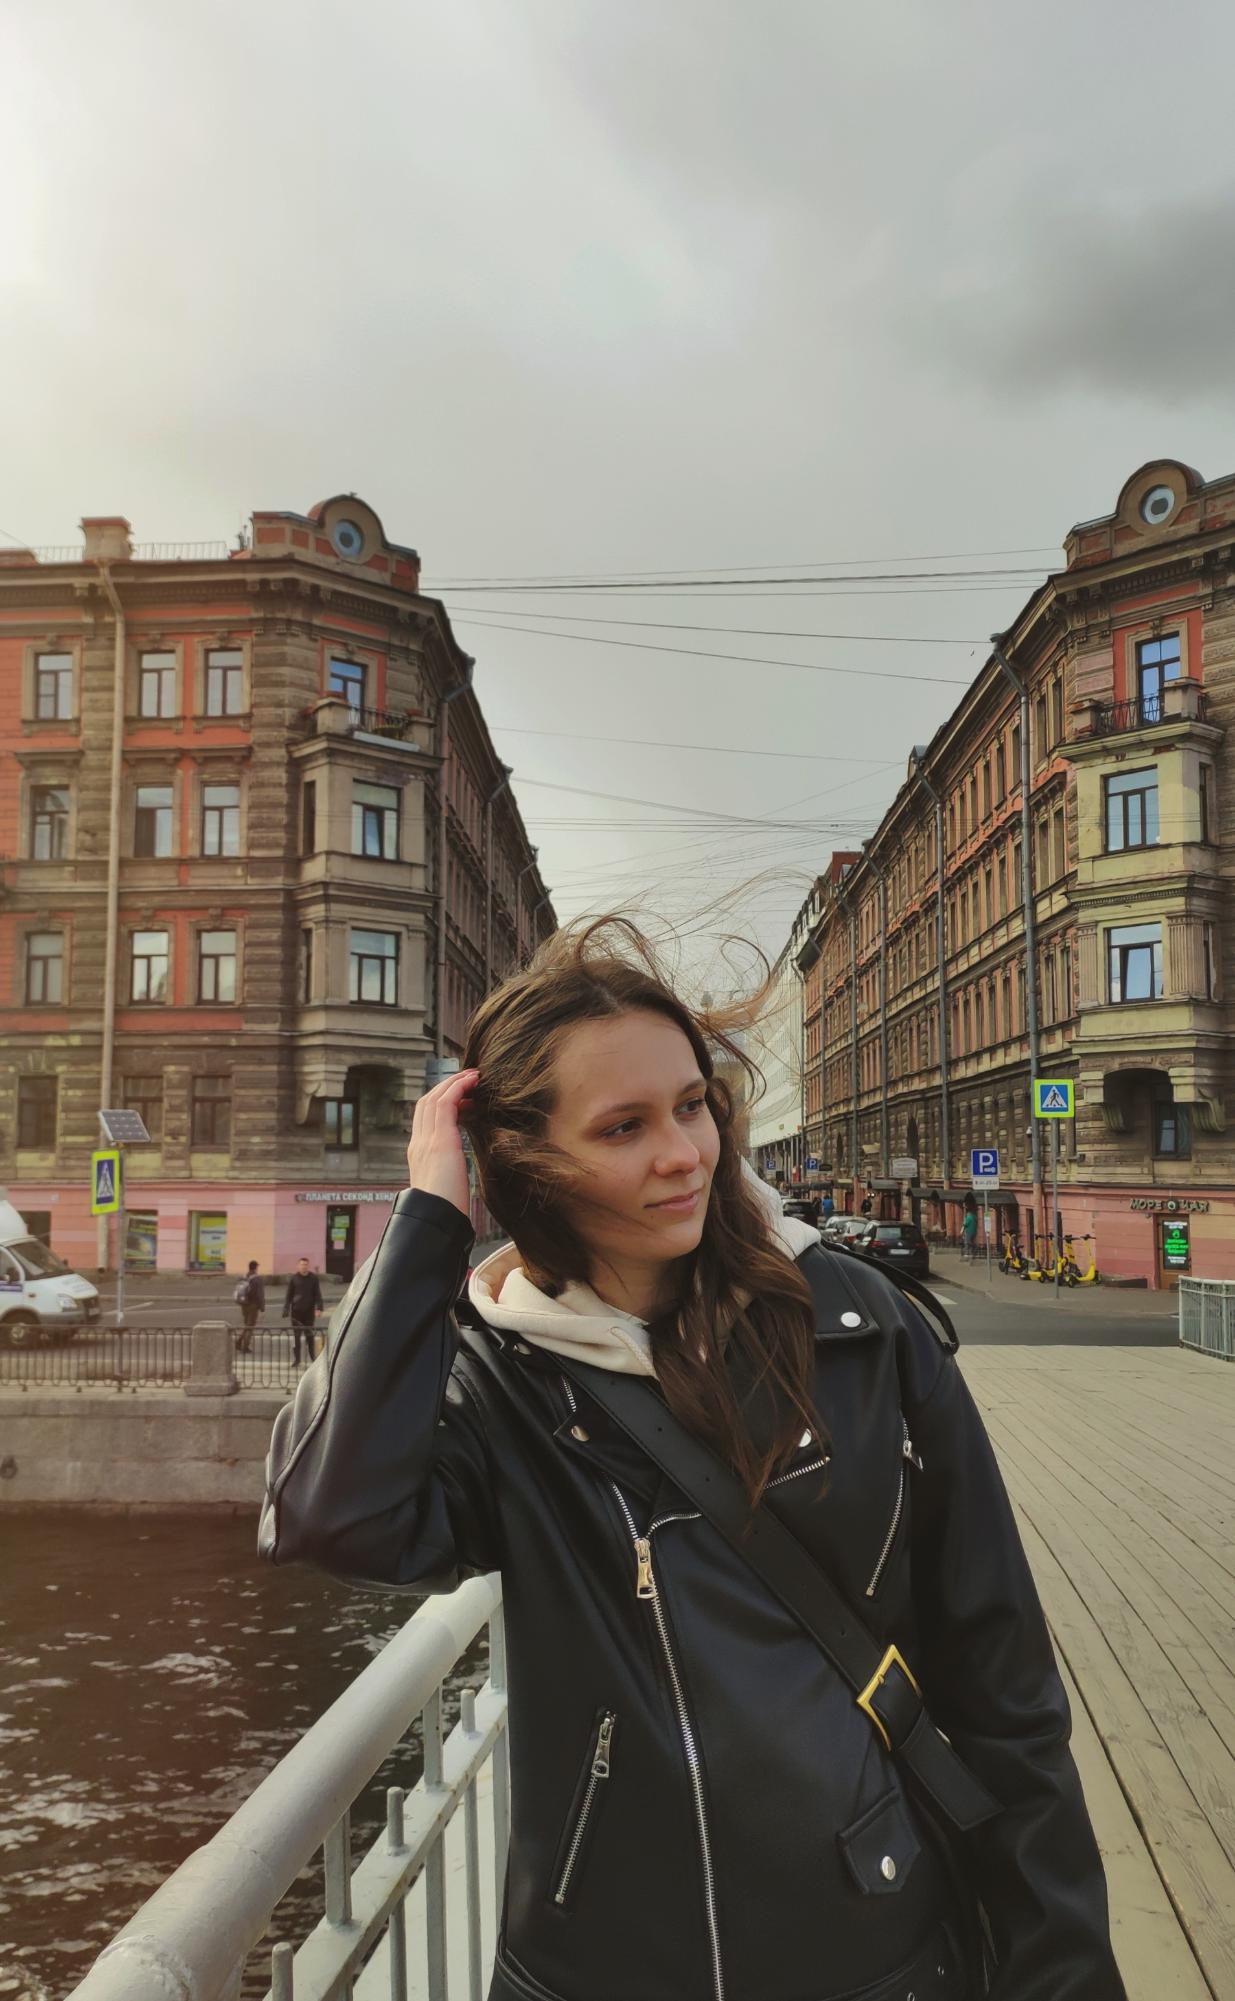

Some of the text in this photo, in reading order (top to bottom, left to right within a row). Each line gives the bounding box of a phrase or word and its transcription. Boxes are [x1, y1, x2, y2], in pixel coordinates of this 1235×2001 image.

[979, 1152, 994, 1173] P
[305, 1192, 341, 1201] ПЛАНЕТА
[342, 1192, 374, 1202] СЕКОНД
[1131, 1198, 1210, 1213] МОРЕ ЧАЯ
